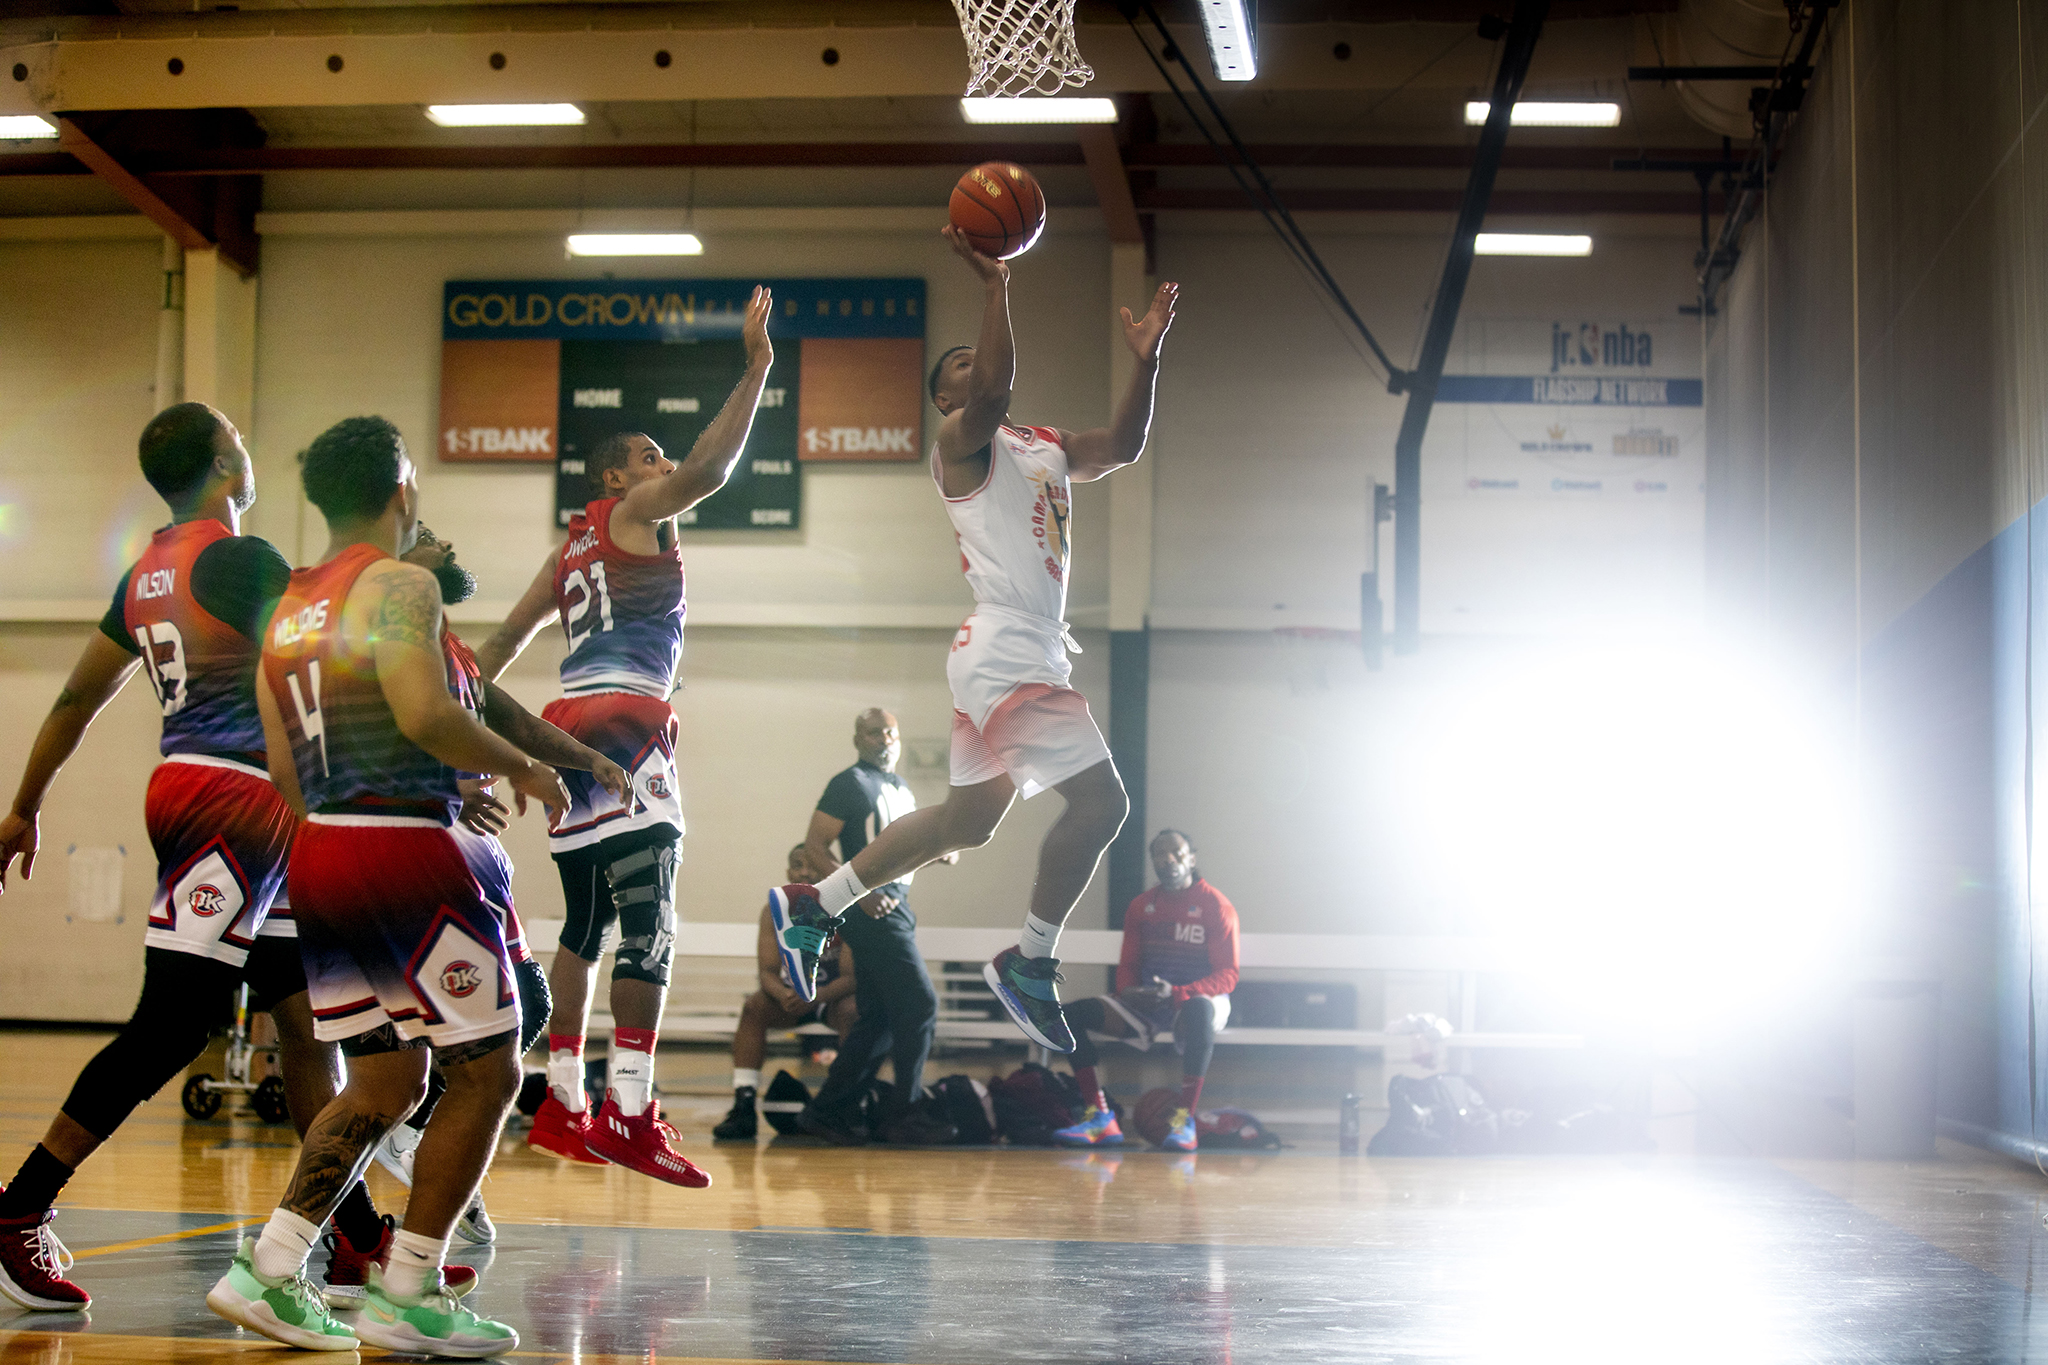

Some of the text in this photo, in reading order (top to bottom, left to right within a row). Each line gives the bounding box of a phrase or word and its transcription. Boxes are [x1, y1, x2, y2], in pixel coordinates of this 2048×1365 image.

[450, 293, 552, 326] GOLD
[557, 293, 695, 326] CROWN
[1603, 321, 1652, 368] nba
[573, 388, 622, 408] HOME
[1601, 380, 1667, 403] NETWORK
[136, 568, 176, 601] WILSON
[563, 560, 614, 655] 21
[135, 621, 188, 717] 13
[286, 657, 330, 778] 4
[1174, 923, 1206, 944] MB
